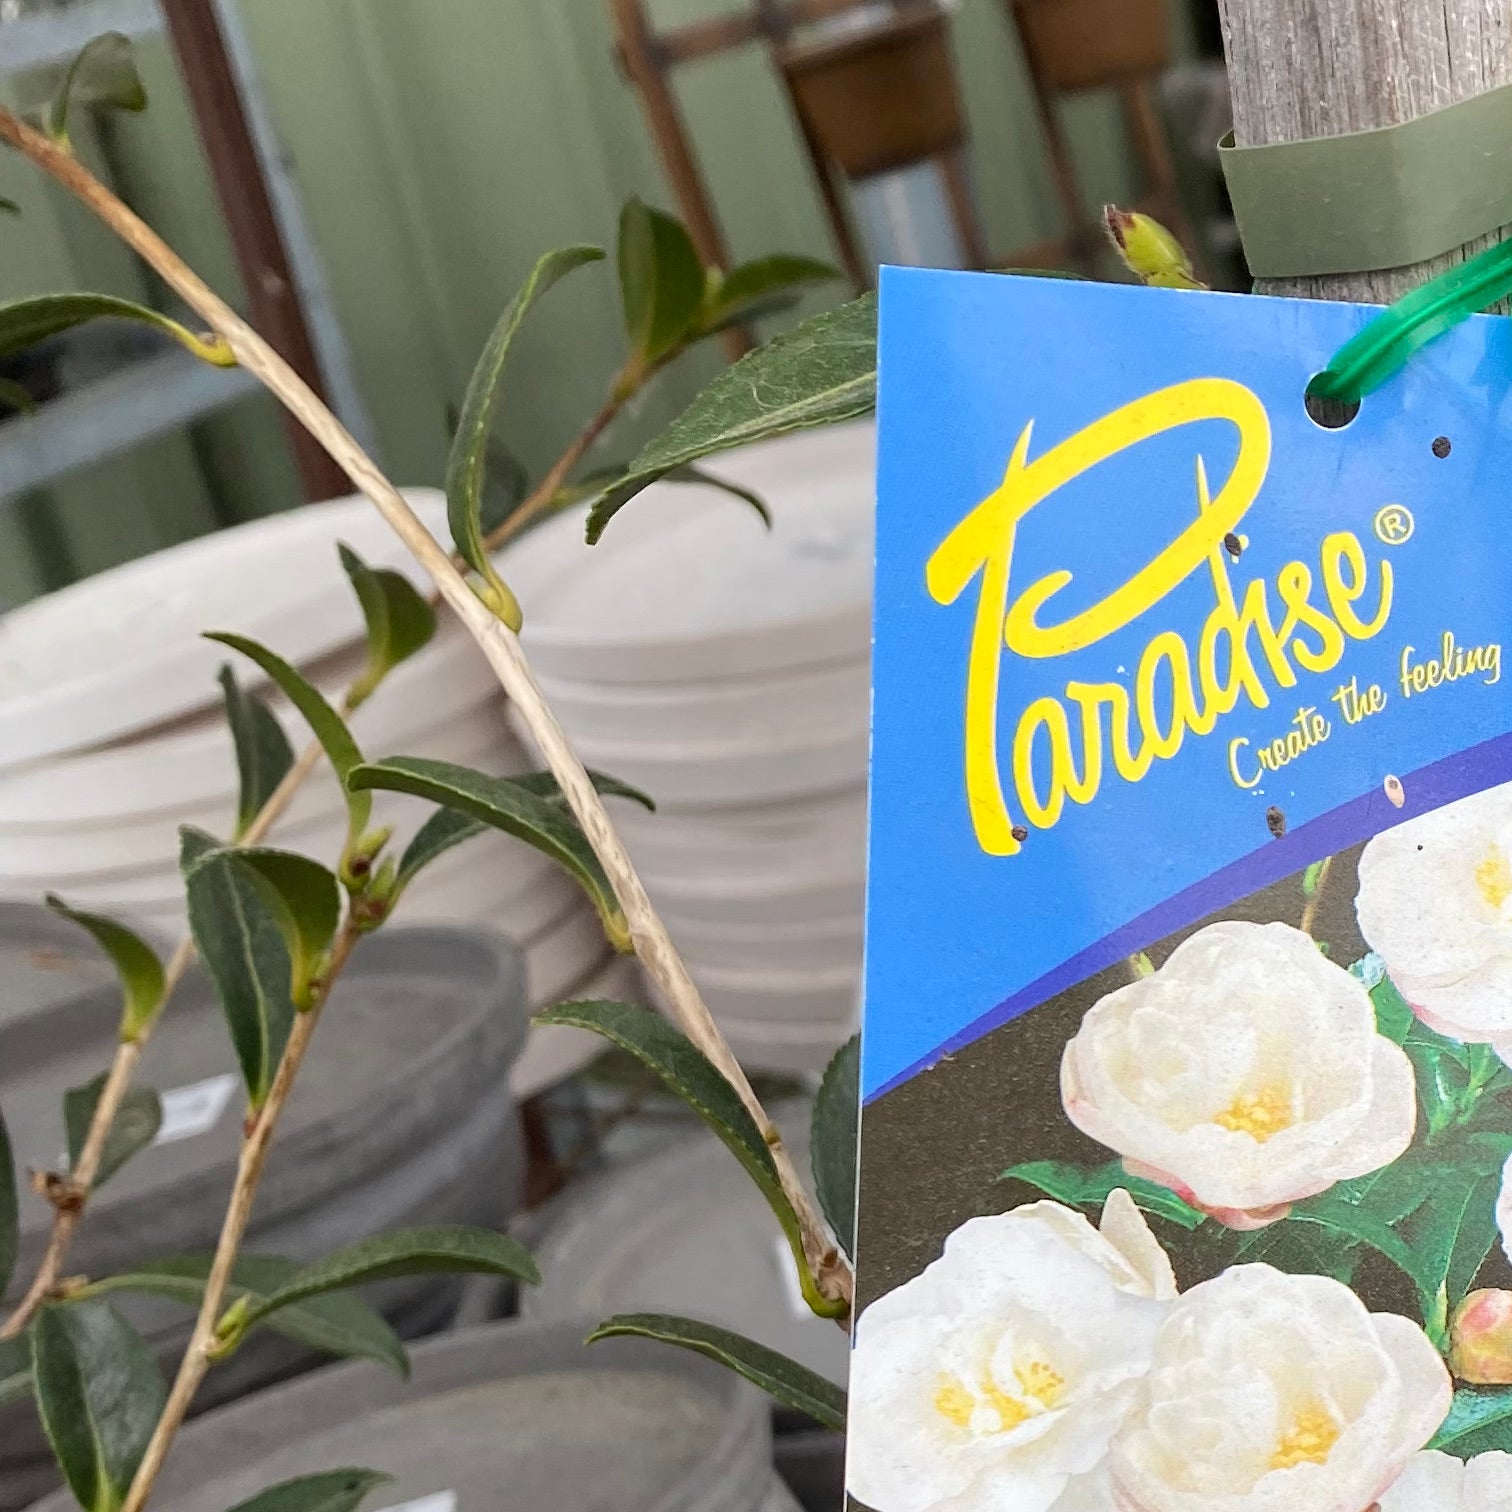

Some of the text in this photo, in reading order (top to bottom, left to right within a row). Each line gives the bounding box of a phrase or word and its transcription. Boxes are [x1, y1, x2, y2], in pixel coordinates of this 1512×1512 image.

[1229, 630, 1503, 789] Create the feeling
